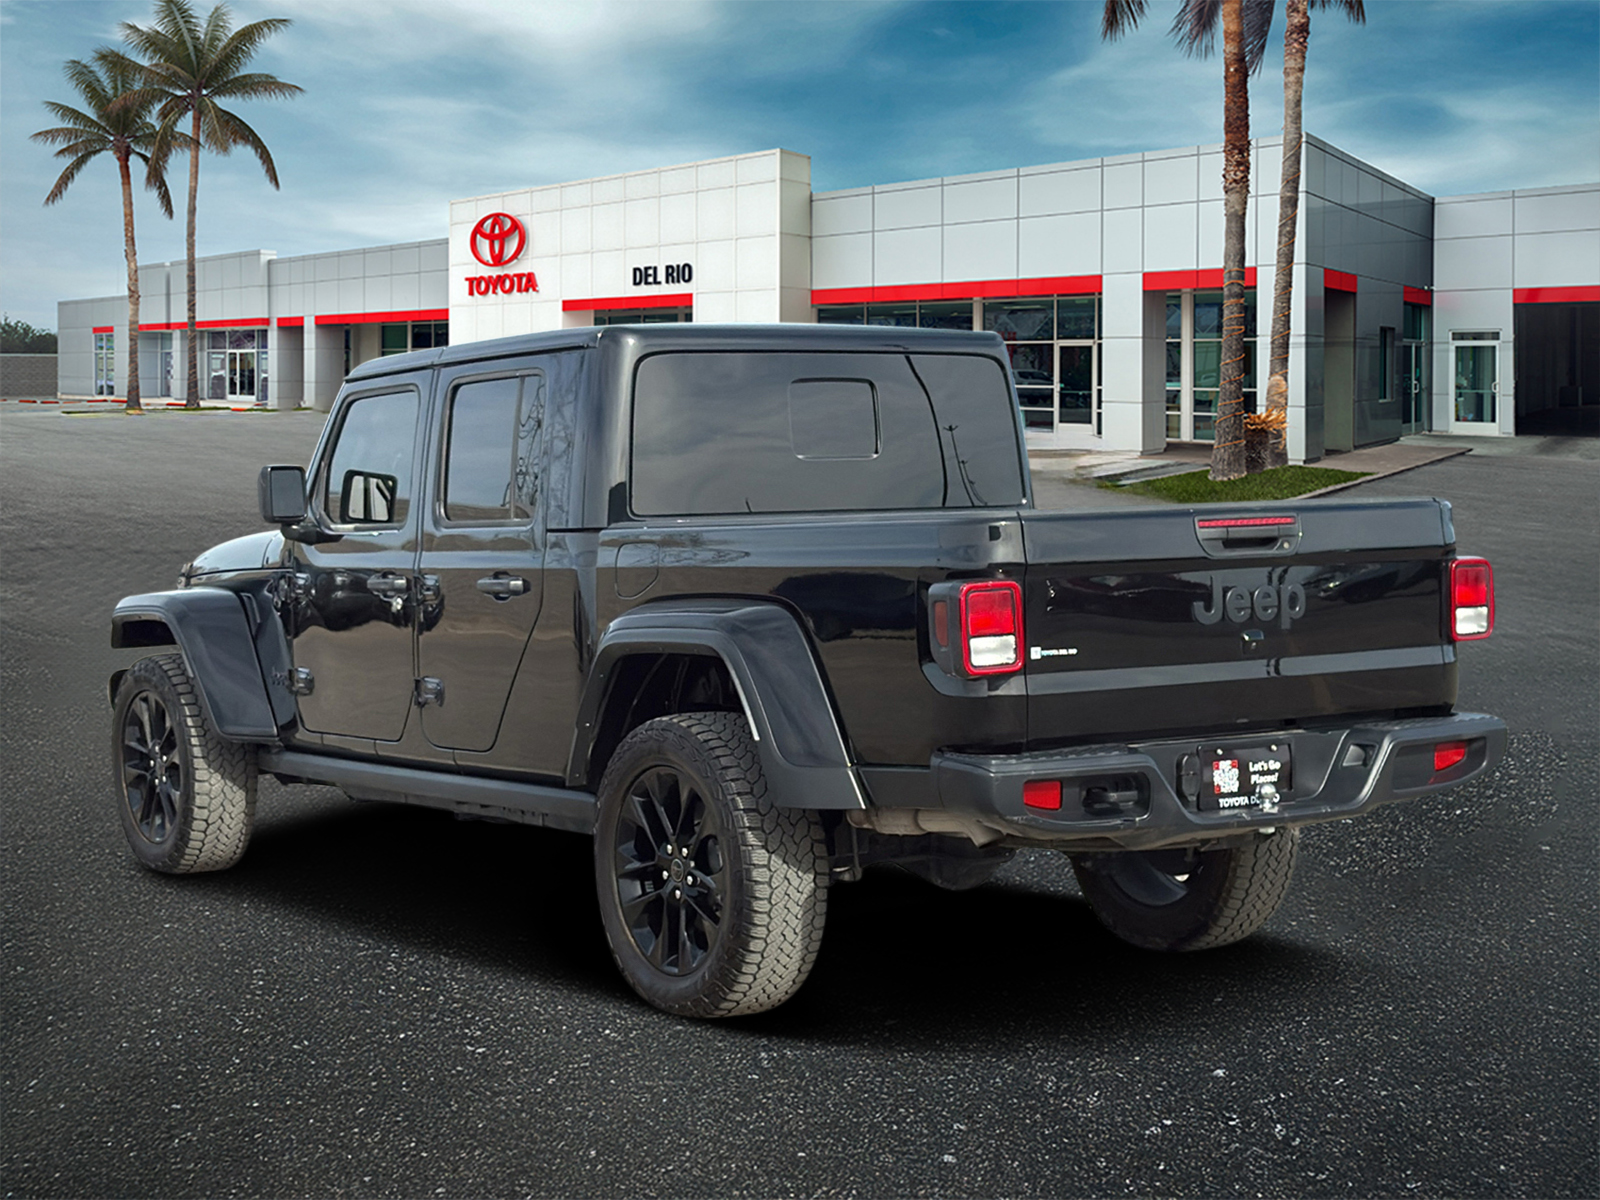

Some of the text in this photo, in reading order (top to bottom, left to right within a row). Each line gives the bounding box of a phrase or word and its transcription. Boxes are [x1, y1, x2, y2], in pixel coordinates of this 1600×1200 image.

[465, 272, 538, 296] TOYOTA
[632, 263, 693, 286] DEL RIO
[1193, 574, 1306, 629] Jeep
[1249, 760, 1281, 772] Let's Go
[1219, 796, 1249, 808] TOYOTA
